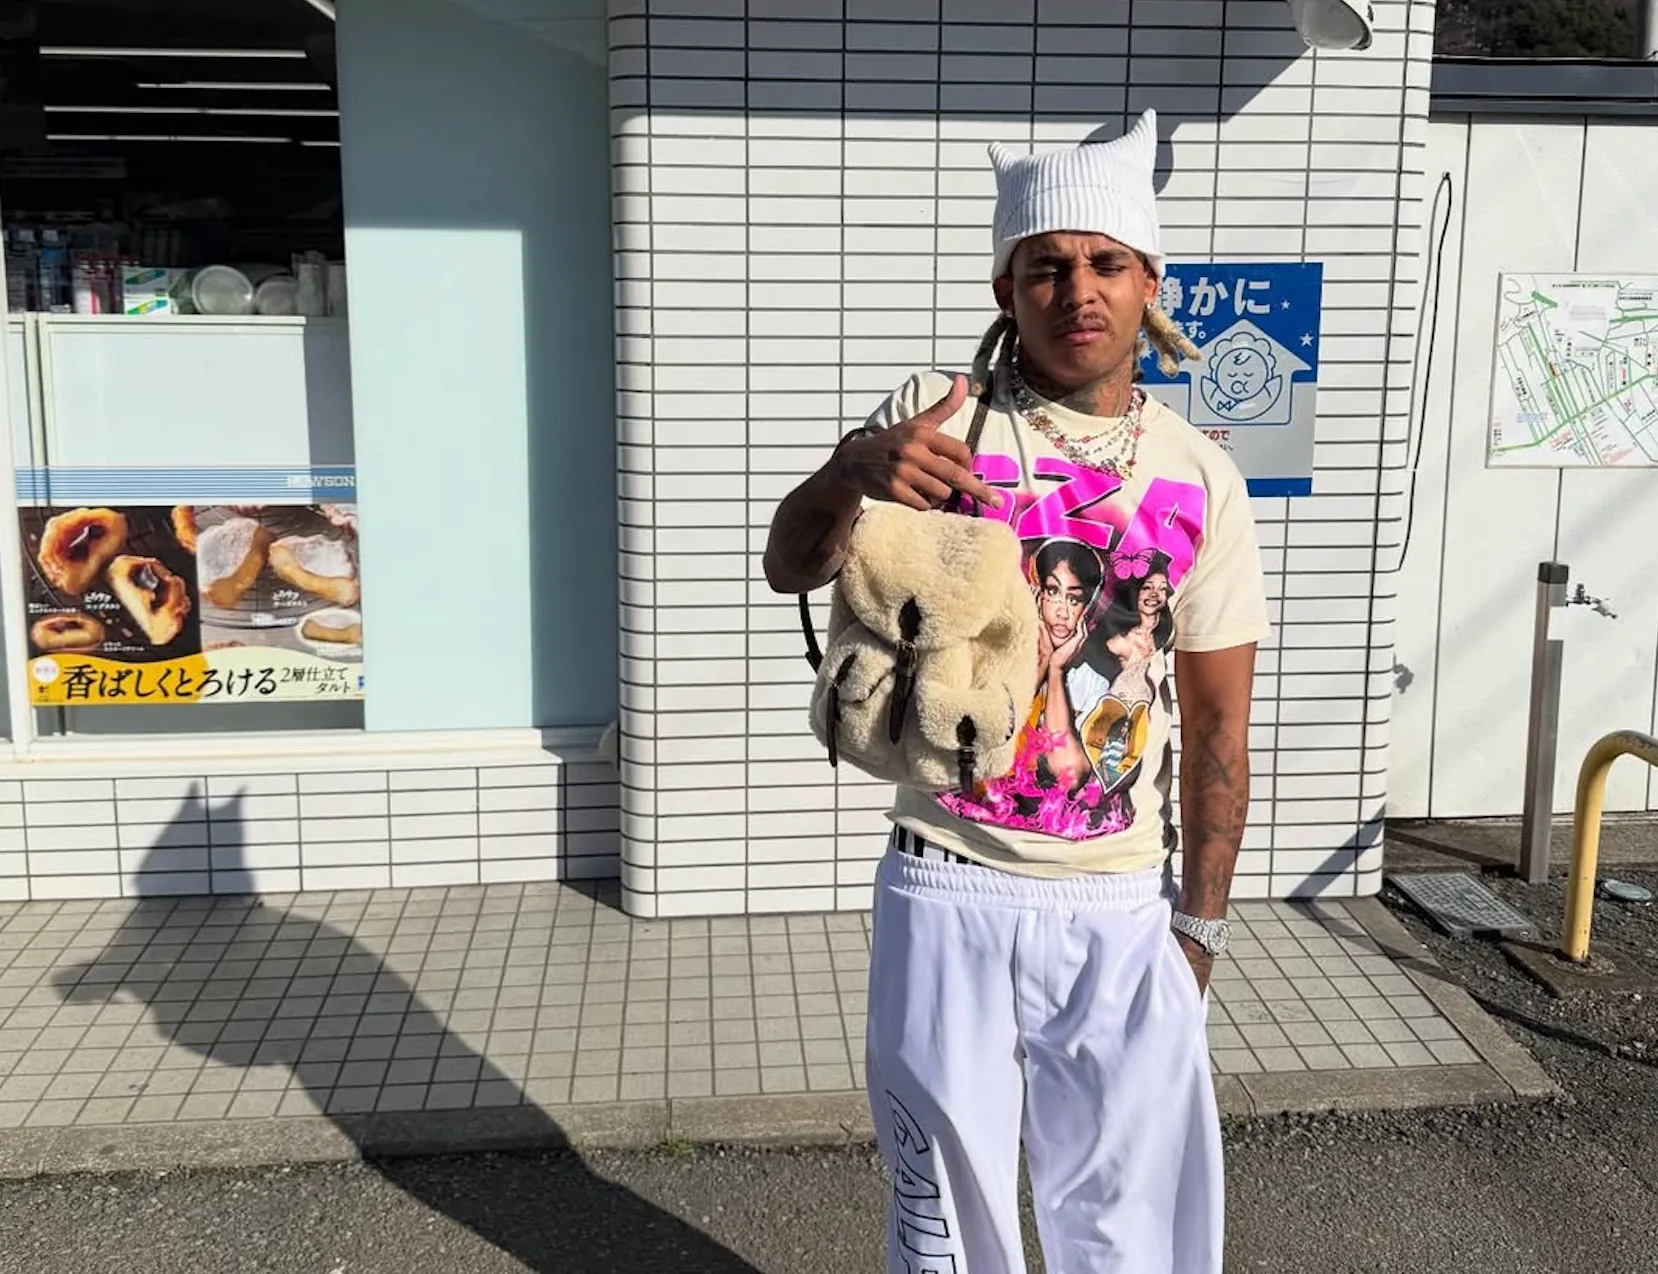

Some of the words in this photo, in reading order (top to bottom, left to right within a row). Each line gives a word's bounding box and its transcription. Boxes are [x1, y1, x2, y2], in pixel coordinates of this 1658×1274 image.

[61, 664, 278, 700] 香ばしくとろける
[279, 665, 349, 682] 2層仕立て
[315, 681, 351, 694] タルト
